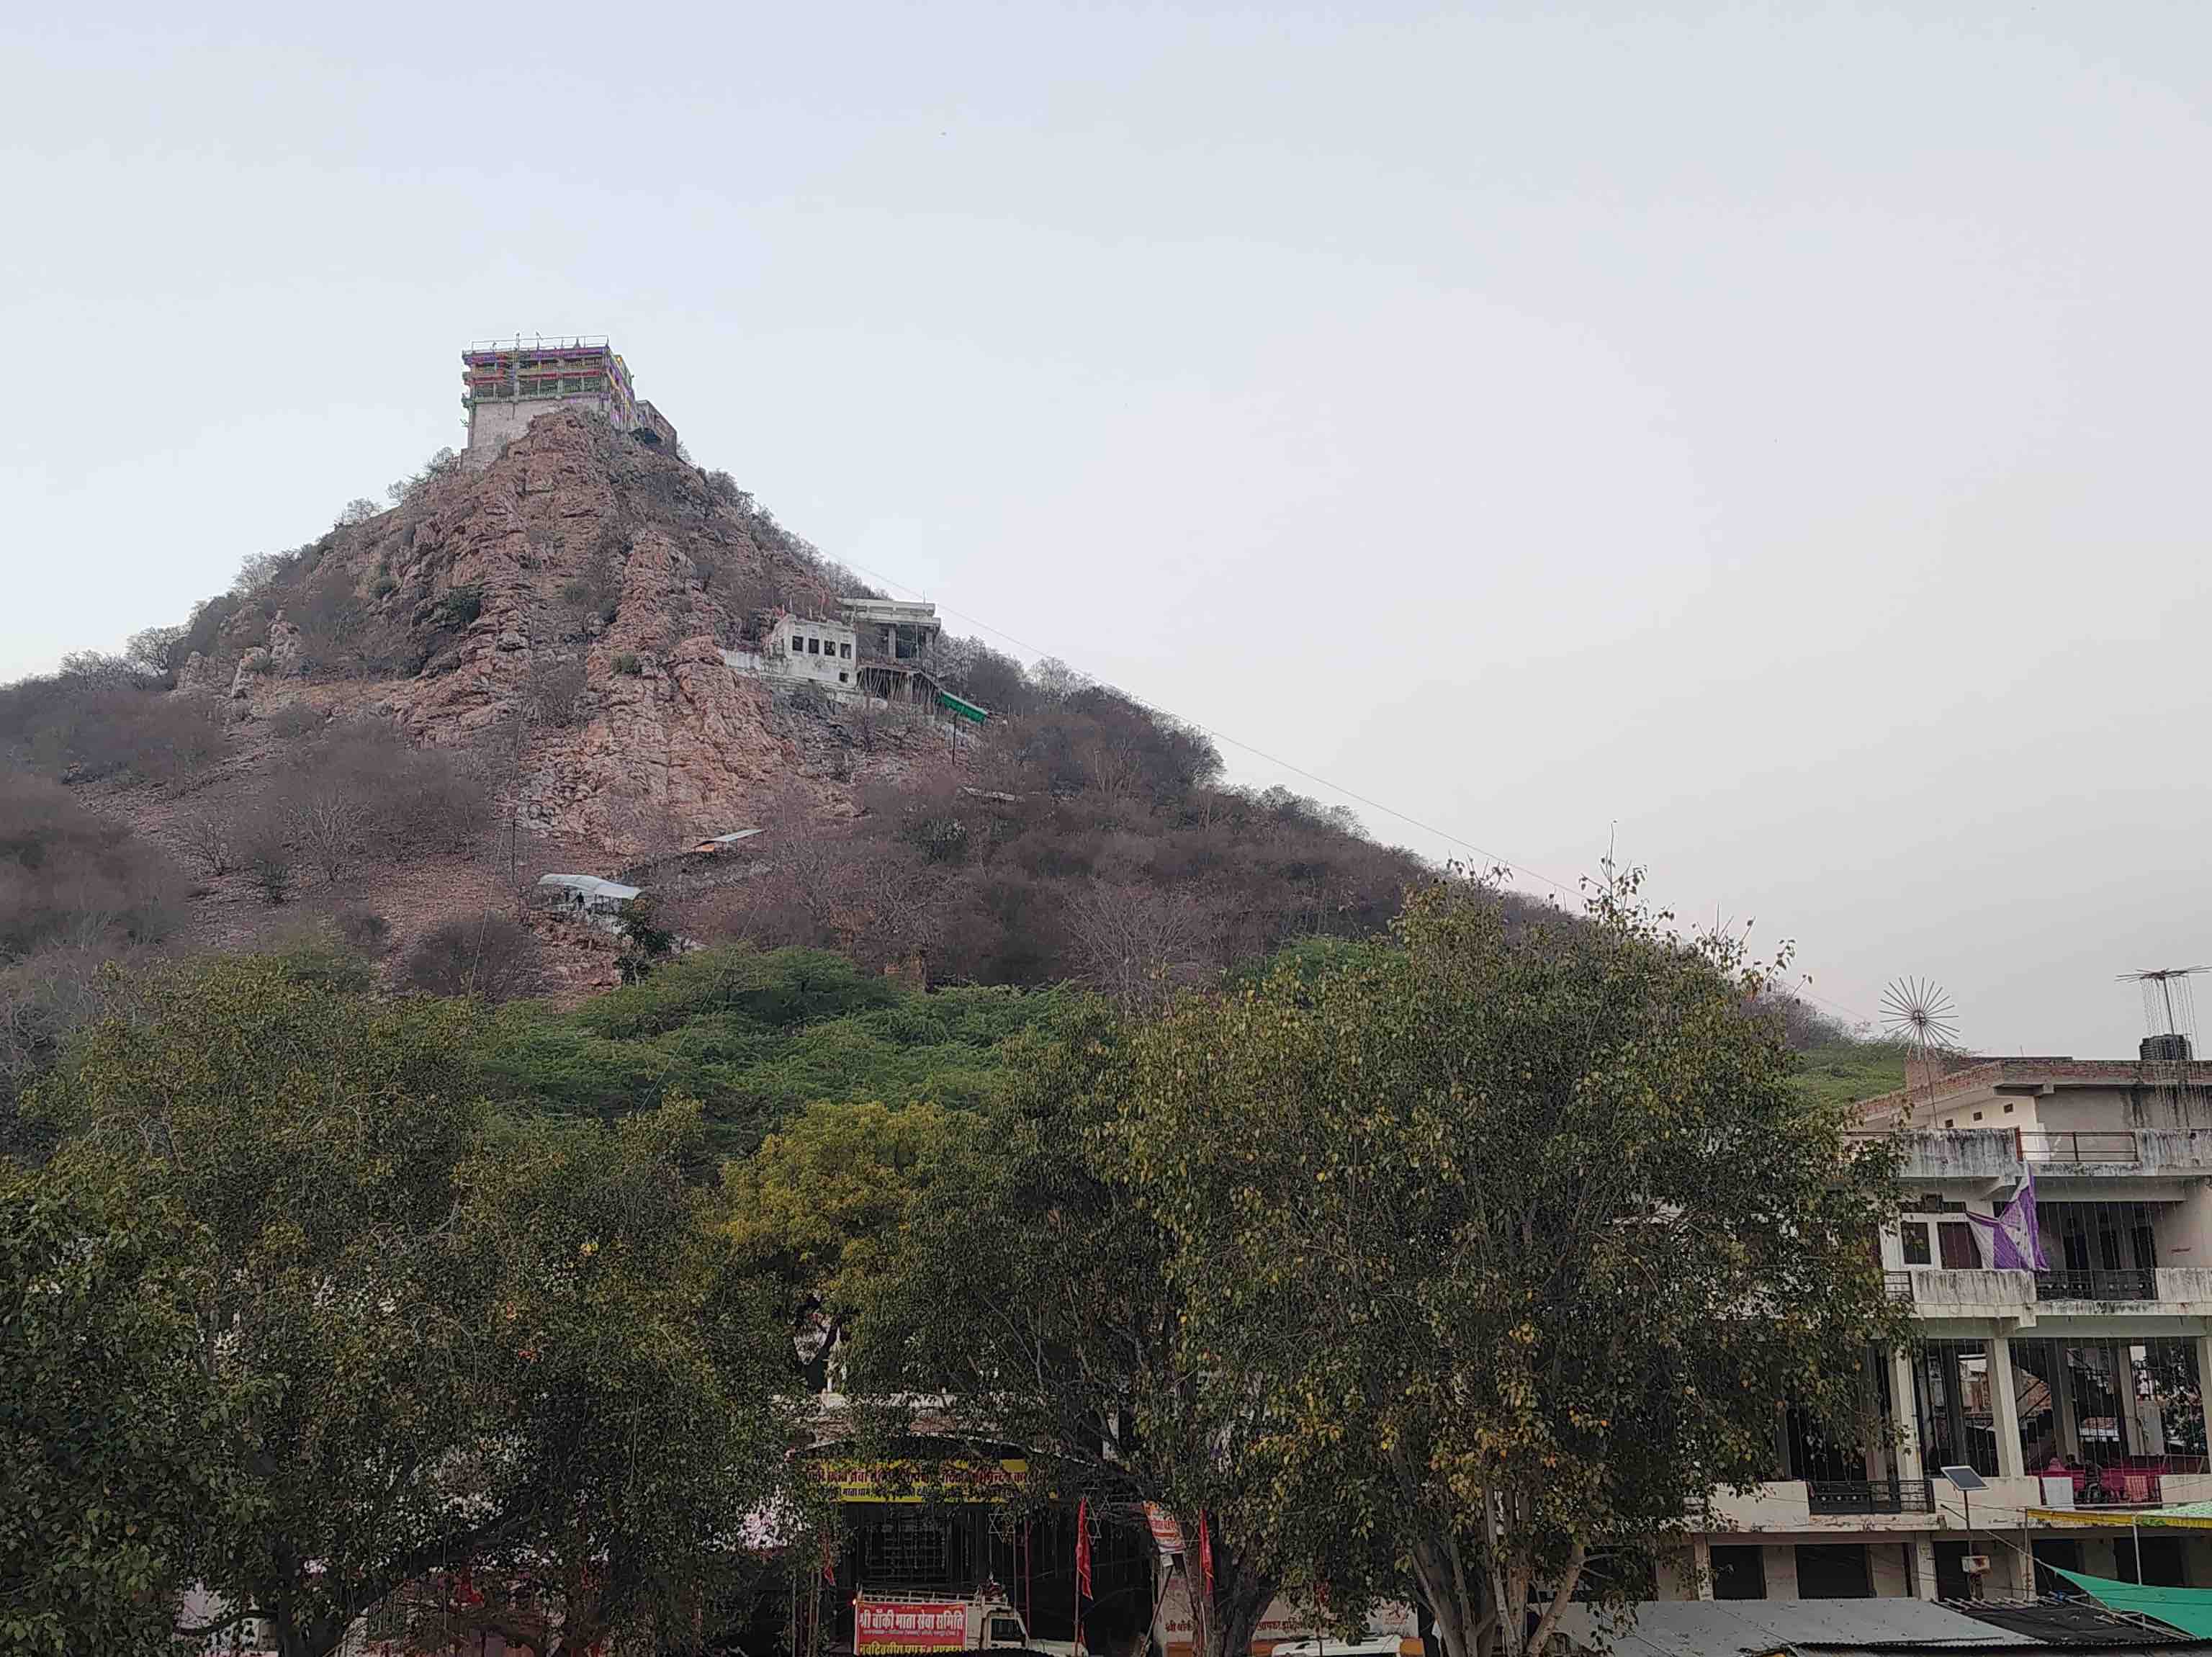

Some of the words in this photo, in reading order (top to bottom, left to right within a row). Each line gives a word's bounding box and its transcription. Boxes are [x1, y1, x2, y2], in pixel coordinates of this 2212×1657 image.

[859, 1609, 871, 1629] श्री
[896, 1614, 916, 1630] माता
[917, 1609, 935, 1630] सेवा
[936, 1610, 963, 1630] समिति
